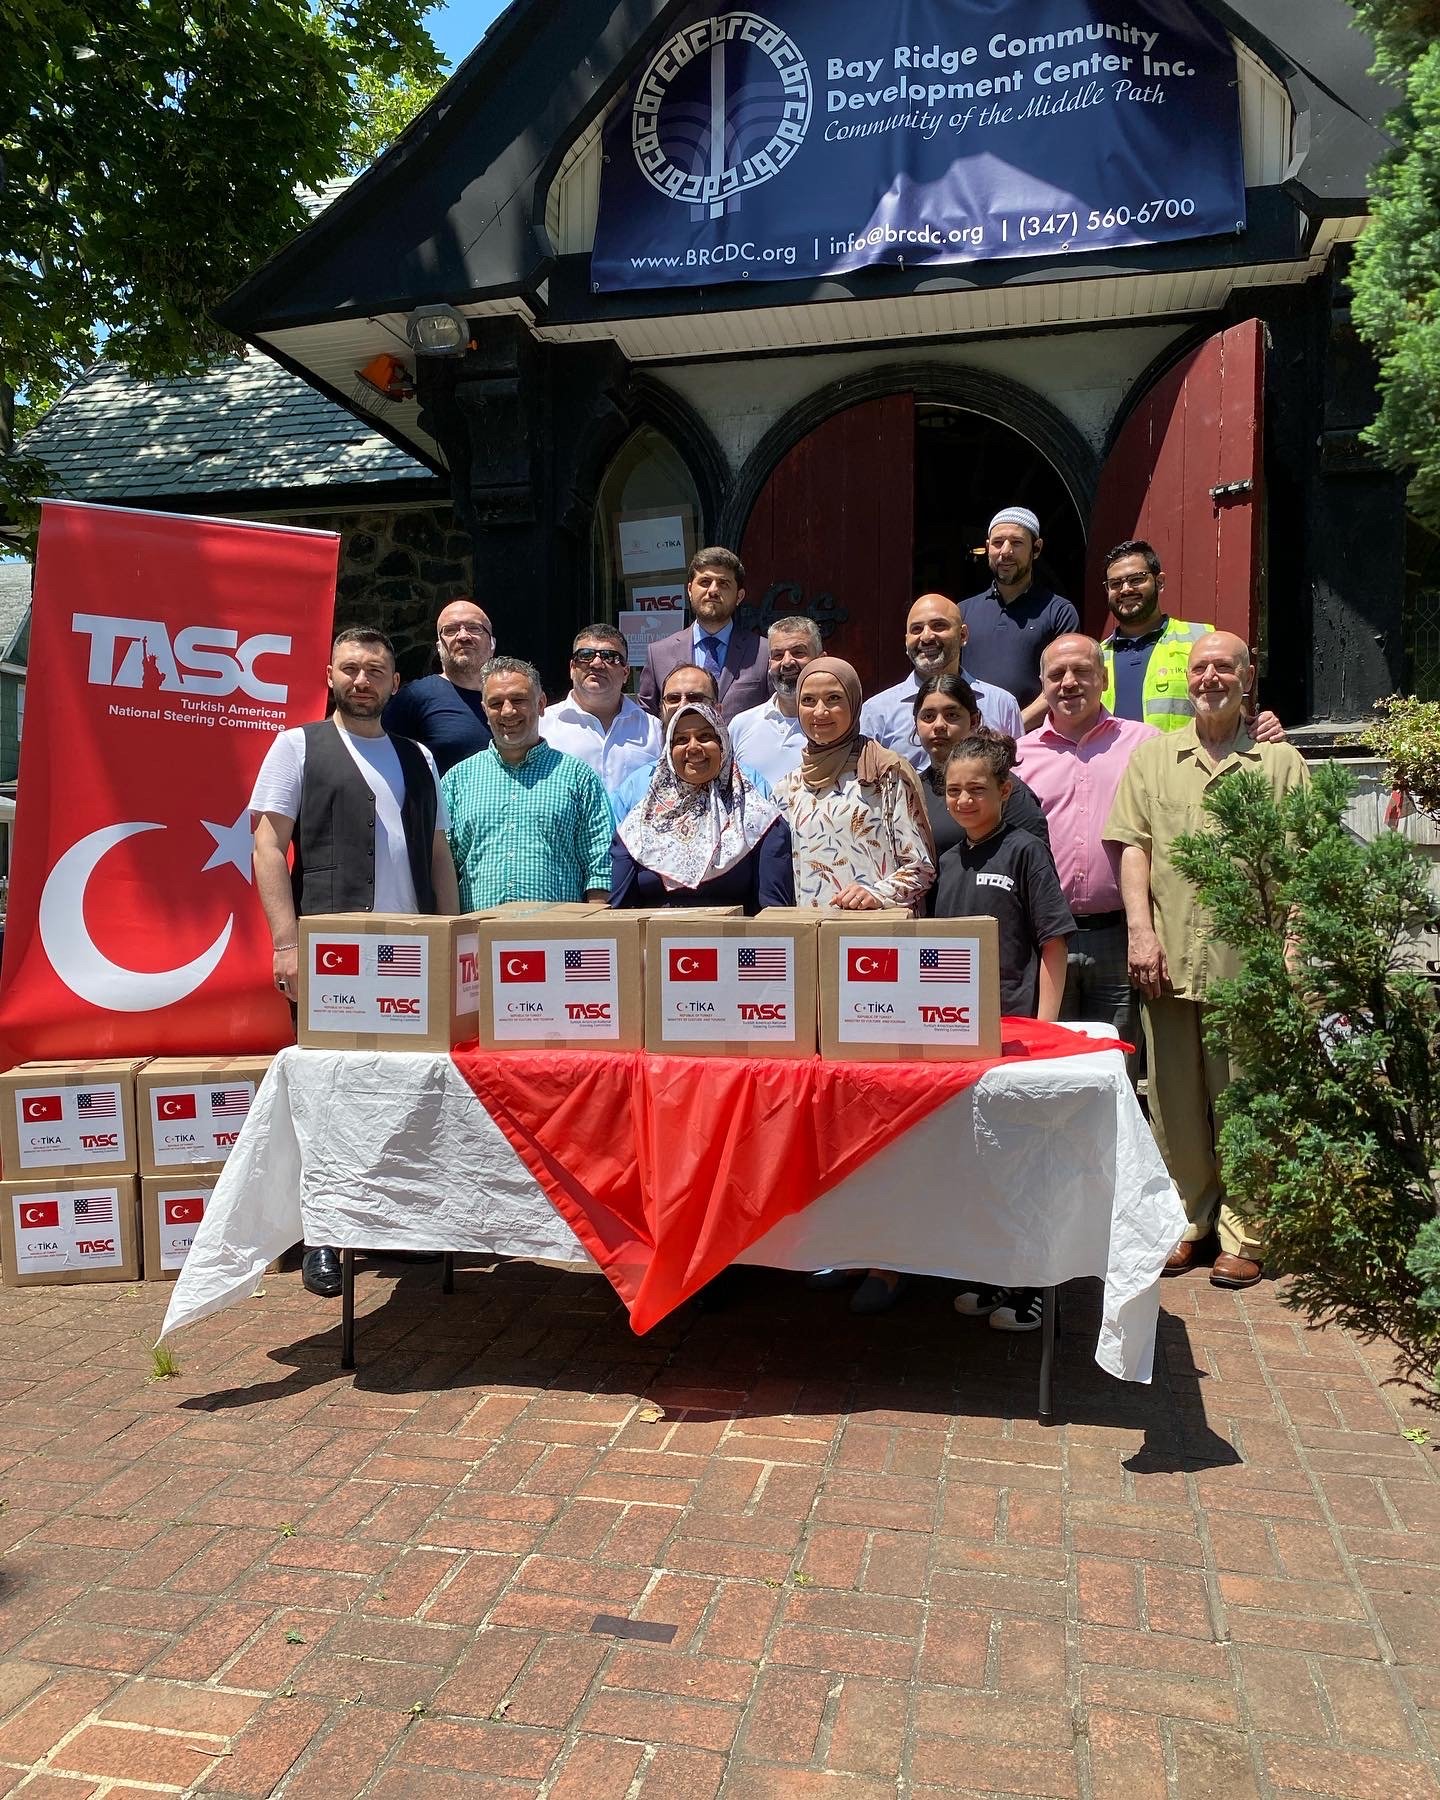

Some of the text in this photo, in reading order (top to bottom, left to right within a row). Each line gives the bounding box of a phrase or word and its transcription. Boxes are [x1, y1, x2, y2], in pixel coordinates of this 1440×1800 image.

[827, 22, 1160, 83] Bay Ridge Community
[827, 52, 1196, 112] Development Center Inc.
[824, 79, 1167, 142] Community of the Middle Path
[630, 242, 797, 269] www.BRCDC.org
[829, 222, 984, 255] info@brcdc.org
[1019, 211, 1079, 241] (347)
[1086, 198, 1196, 231] 560-6700
[635, 595, 683, 611] TASC
[71, 612, 292, 704] TASC
[180, 699, 286, 719] Turkish American
[108, 704, 286, 733] National Steering Committee
[376, 998, 420, 1014] TASC
[519, 1001, 544, 1012] TİKA
[565, 1004, 611, 1019] TASC
[689, 1001, 715, 1012] TİKA
[737, 1004, 786, 1020] TASC
[867, 1002, 895, 1013] TİKA
[918, 1006, 970, 1023] TASC
[80, 1134, 118, 1148] TASC
[213, 1132, 239, 1146] TAS
[76, 1239, 115, 1253] TASC
